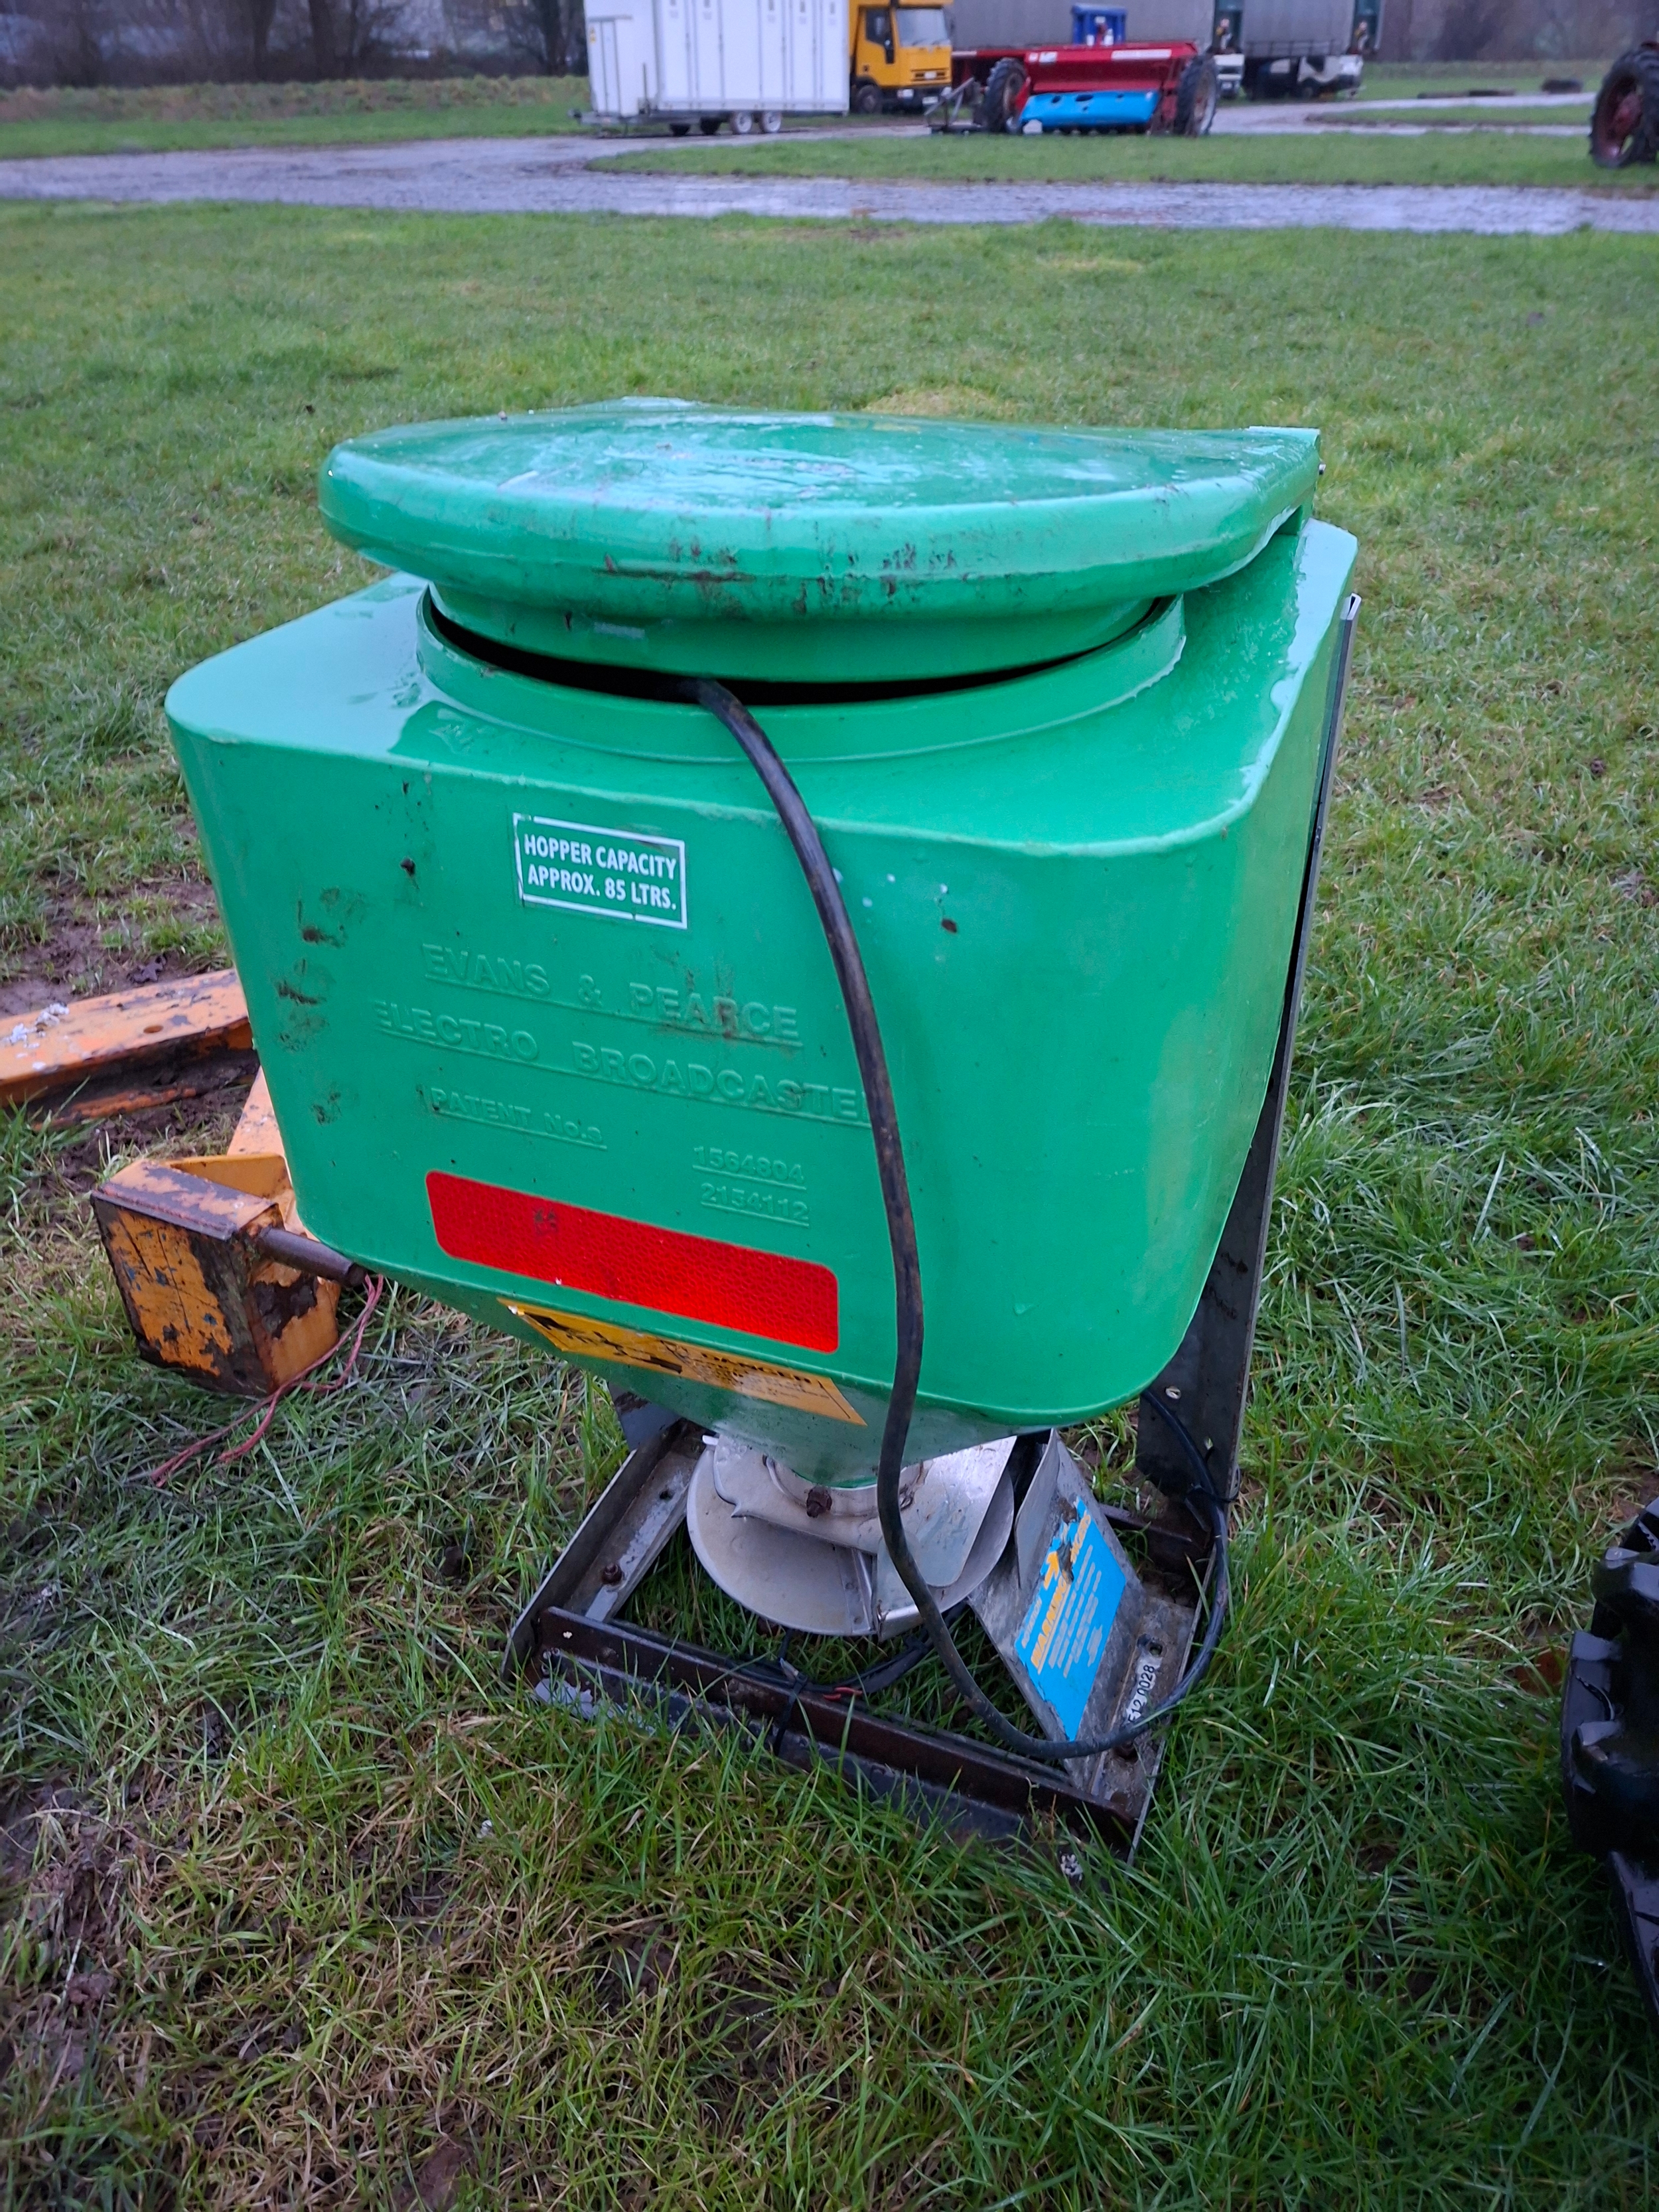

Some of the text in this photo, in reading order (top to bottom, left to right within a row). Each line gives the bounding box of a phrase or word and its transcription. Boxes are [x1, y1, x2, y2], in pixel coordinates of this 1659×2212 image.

[524, 834, 676, 880] HOPPER CAPACITY
[528, 863, 676, 911] APPROX. 85 LTRS.
[422, 943, 799, 1038] EVANS & PEARCE
[374, 999, 868, 1120] ELECTRO BROADCASTE
[431, 1088, 531, 1126] PATENT
[693, 1145, 804, 1183] 1564804
[1031, 1575, 1067, 1669] WARNING
